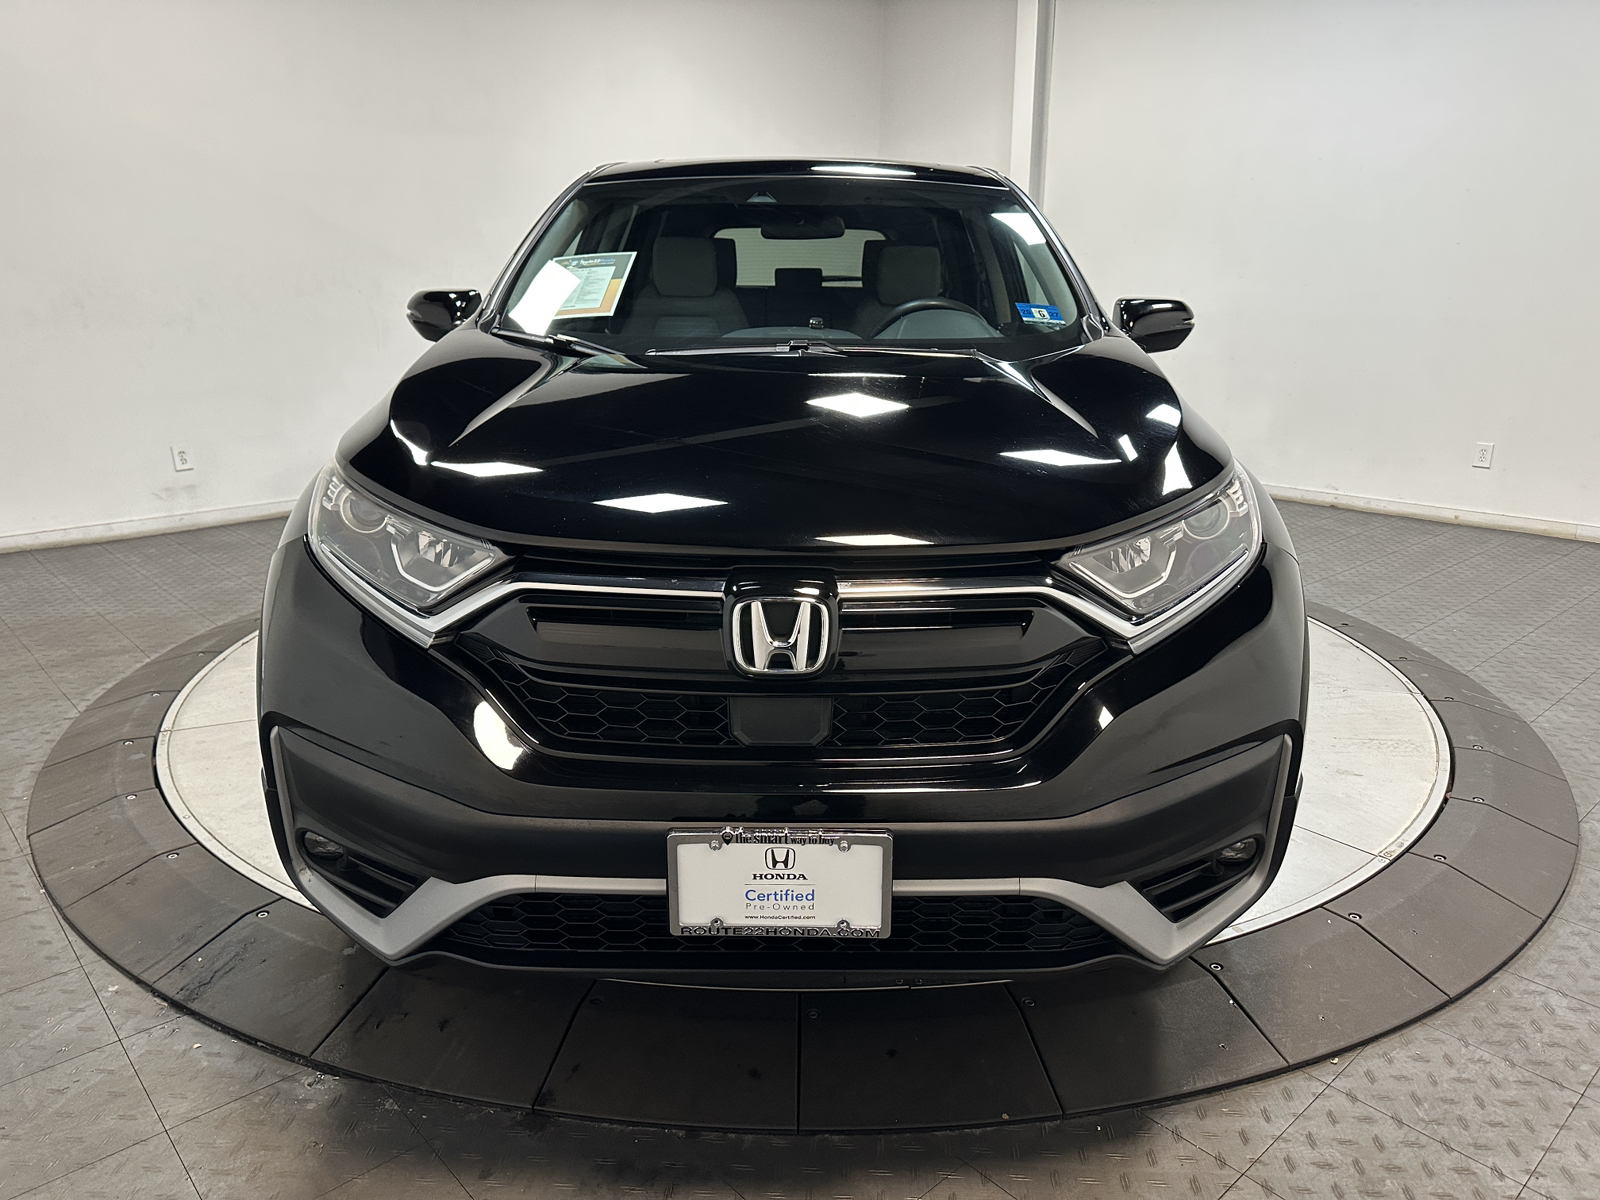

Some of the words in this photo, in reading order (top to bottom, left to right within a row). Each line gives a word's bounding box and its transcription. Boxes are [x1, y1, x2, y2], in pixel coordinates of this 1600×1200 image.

[1038, 310, 1046, 318] 6
[735, 833, 752, 844] the
[753, 832, 789, 844] smart
[790, 836, 807, 846] way
[808, 835, 818, 845] to
[818, 834, 835, 846] buy
[745, 889, 815, 902] Certified
[746, 903, 815, 911] Pre-Owned
[680, 926, 880, 937] ROUTE22HONDA.COM
